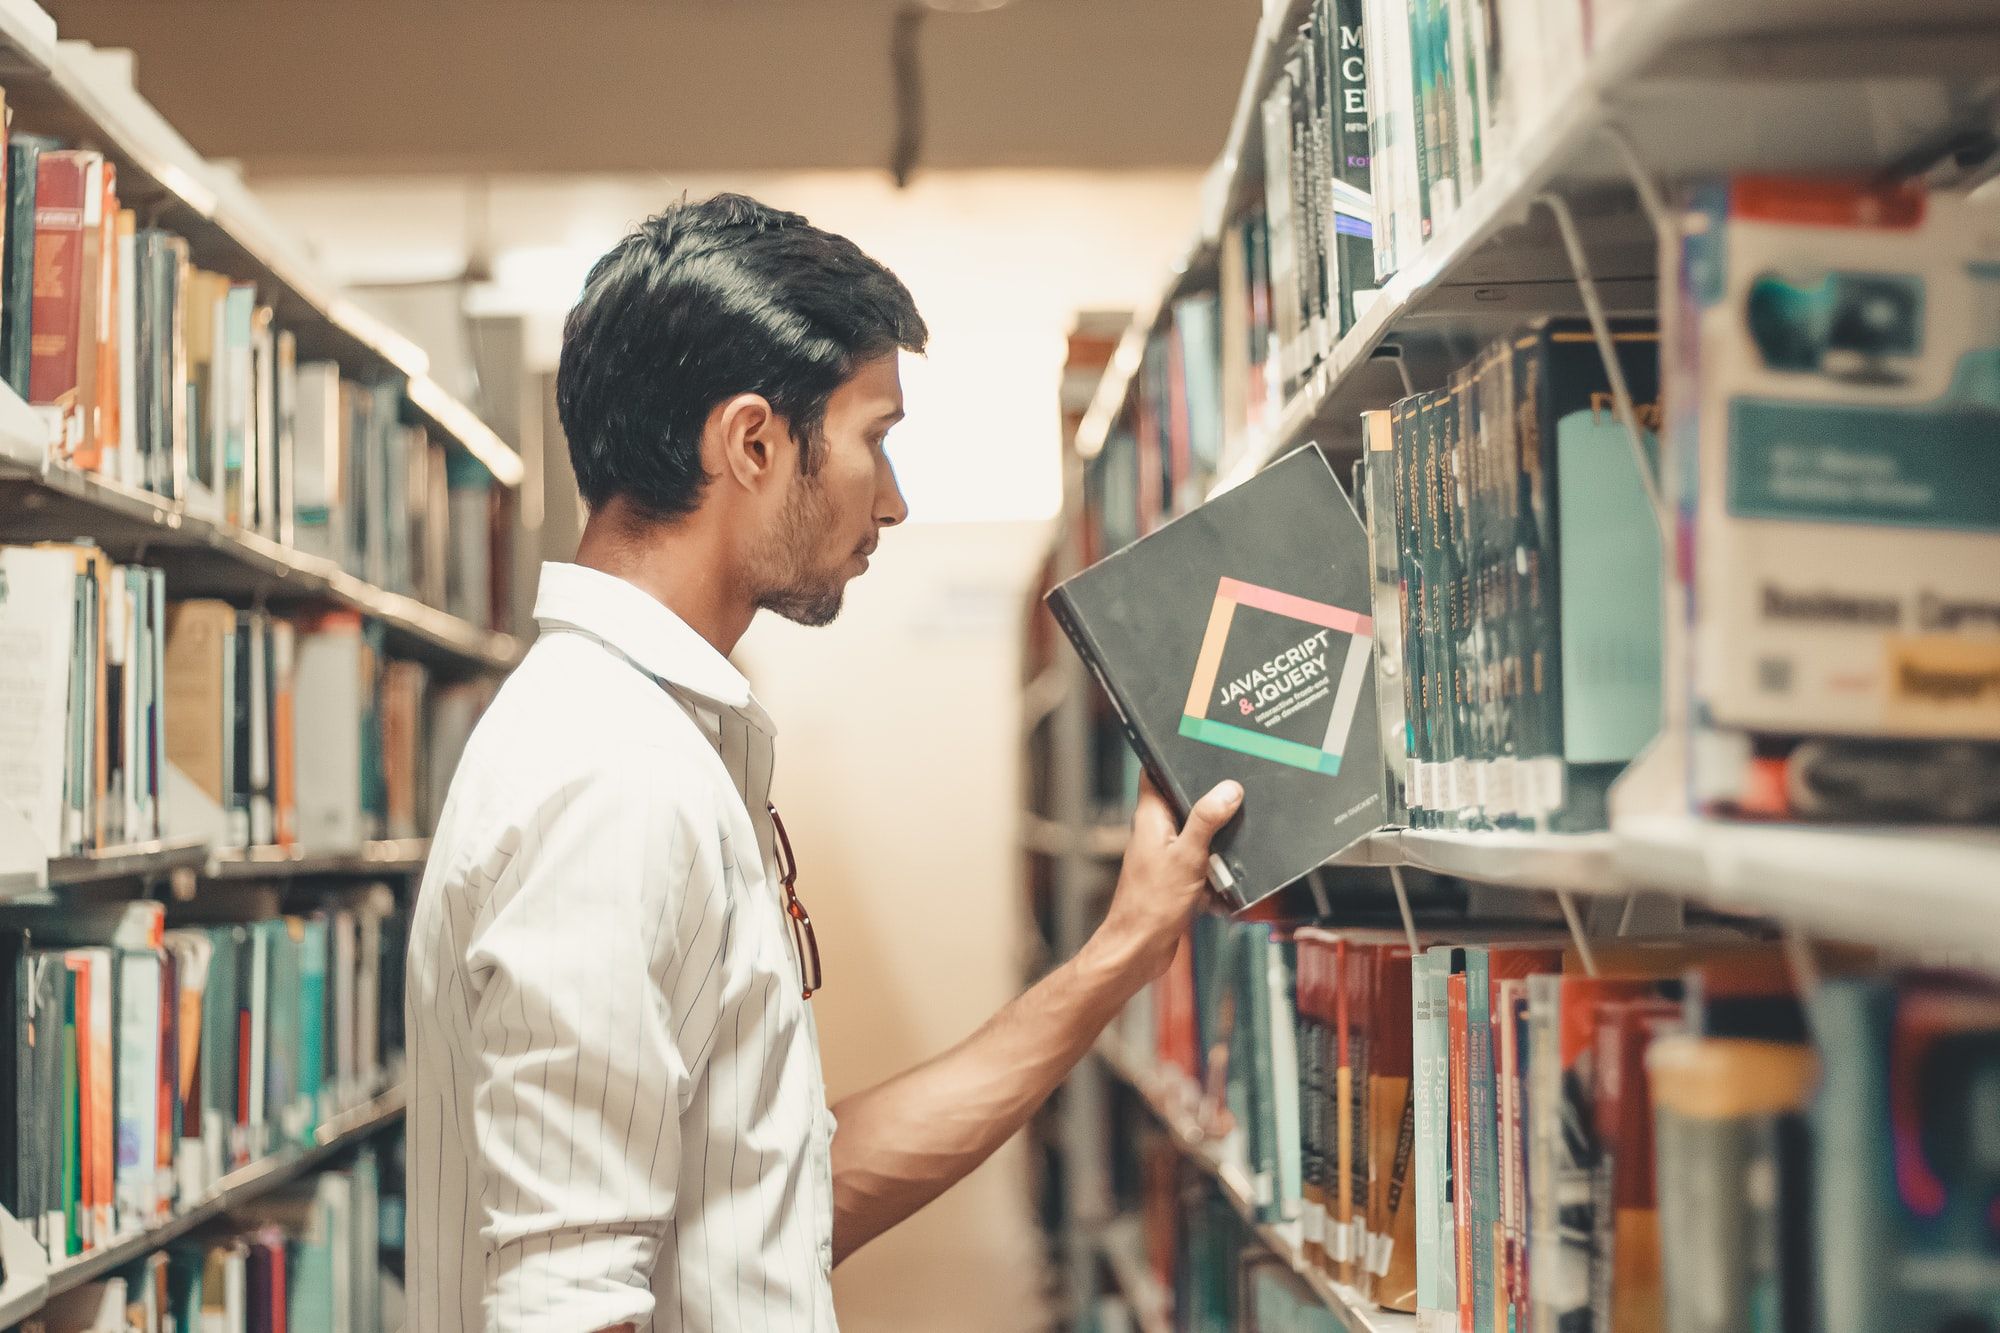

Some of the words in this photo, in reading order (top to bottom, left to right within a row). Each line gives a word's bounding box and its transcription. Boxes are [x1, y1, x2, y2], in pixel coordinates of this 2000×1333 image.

[1342, 57, 1364, 82] C
[1344, 88, 1367, 113] E
[1220, 629, 1329, 705] JAVASCRIPT
[1238, 697, 1255, 716] &
[1254, 653, 1327, 708] JQUERY
[1417, 1057, 1432, 1139] Digital
